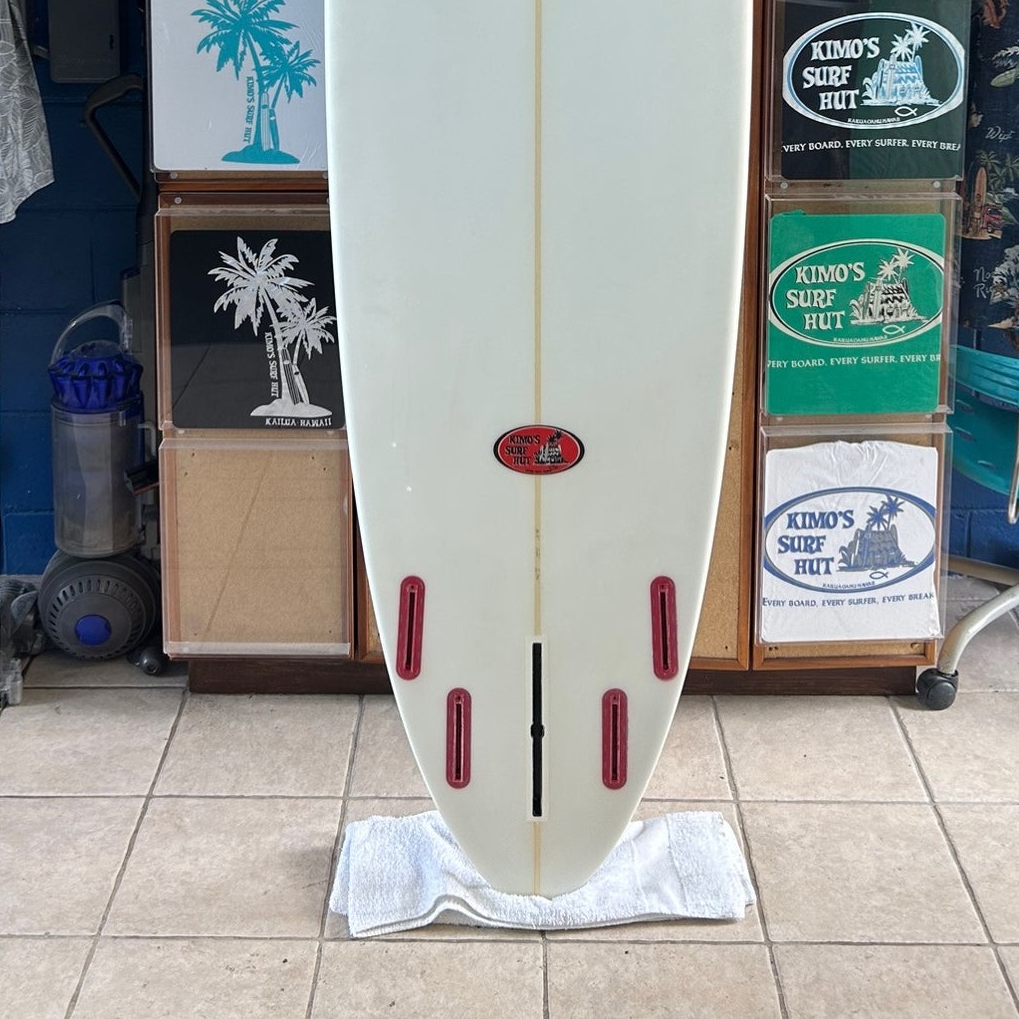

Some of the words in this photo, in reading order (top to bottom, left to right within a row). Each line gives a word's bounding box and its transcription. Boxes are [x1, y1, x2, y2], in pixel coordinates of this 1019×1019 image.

[811, 37, 880, 61] KIMO'S
[802, 65, 852, 89] SURF
[819, 90, 859, 111] HUT
[246, 105, 255, 124] SURF
[244, 127, 252, 143] HUT
[781, 143, 805, 152] VERY
[809, 141, 843, 150] BOARD.
[846, 140, 873, 148] EVERY
[875, 139, 909, 147] SURFER.
[912, 140, 938, 149] EVERY
[795, 262, 865, 283] KIMO'S
[786, 289, 836, 309] SURF
[804, 311, 845, 330] HUT
[269, 360, 278, 380] SURF
[791, 359, 827, 368] BOARD.
[830, 357, 858, 365] EVERY
[861, 355, 897, 364] SURFER.
[900, 355, 927, 363] EVERY
[301, 418, 331, 427] HAWAII
[509, 435, 540, 444] KIMO'S
[505, 446, 528, 456] SURF
[513, 457, 532, 465] HUT
[786, 510, 855, 530] KIMO'S
[777, 535, 826, 554] SURF
[794, 557, 834, 575] HUT
[822, 598, 845, 606] EVERY
[882, 595, 905, 603] EVERY
